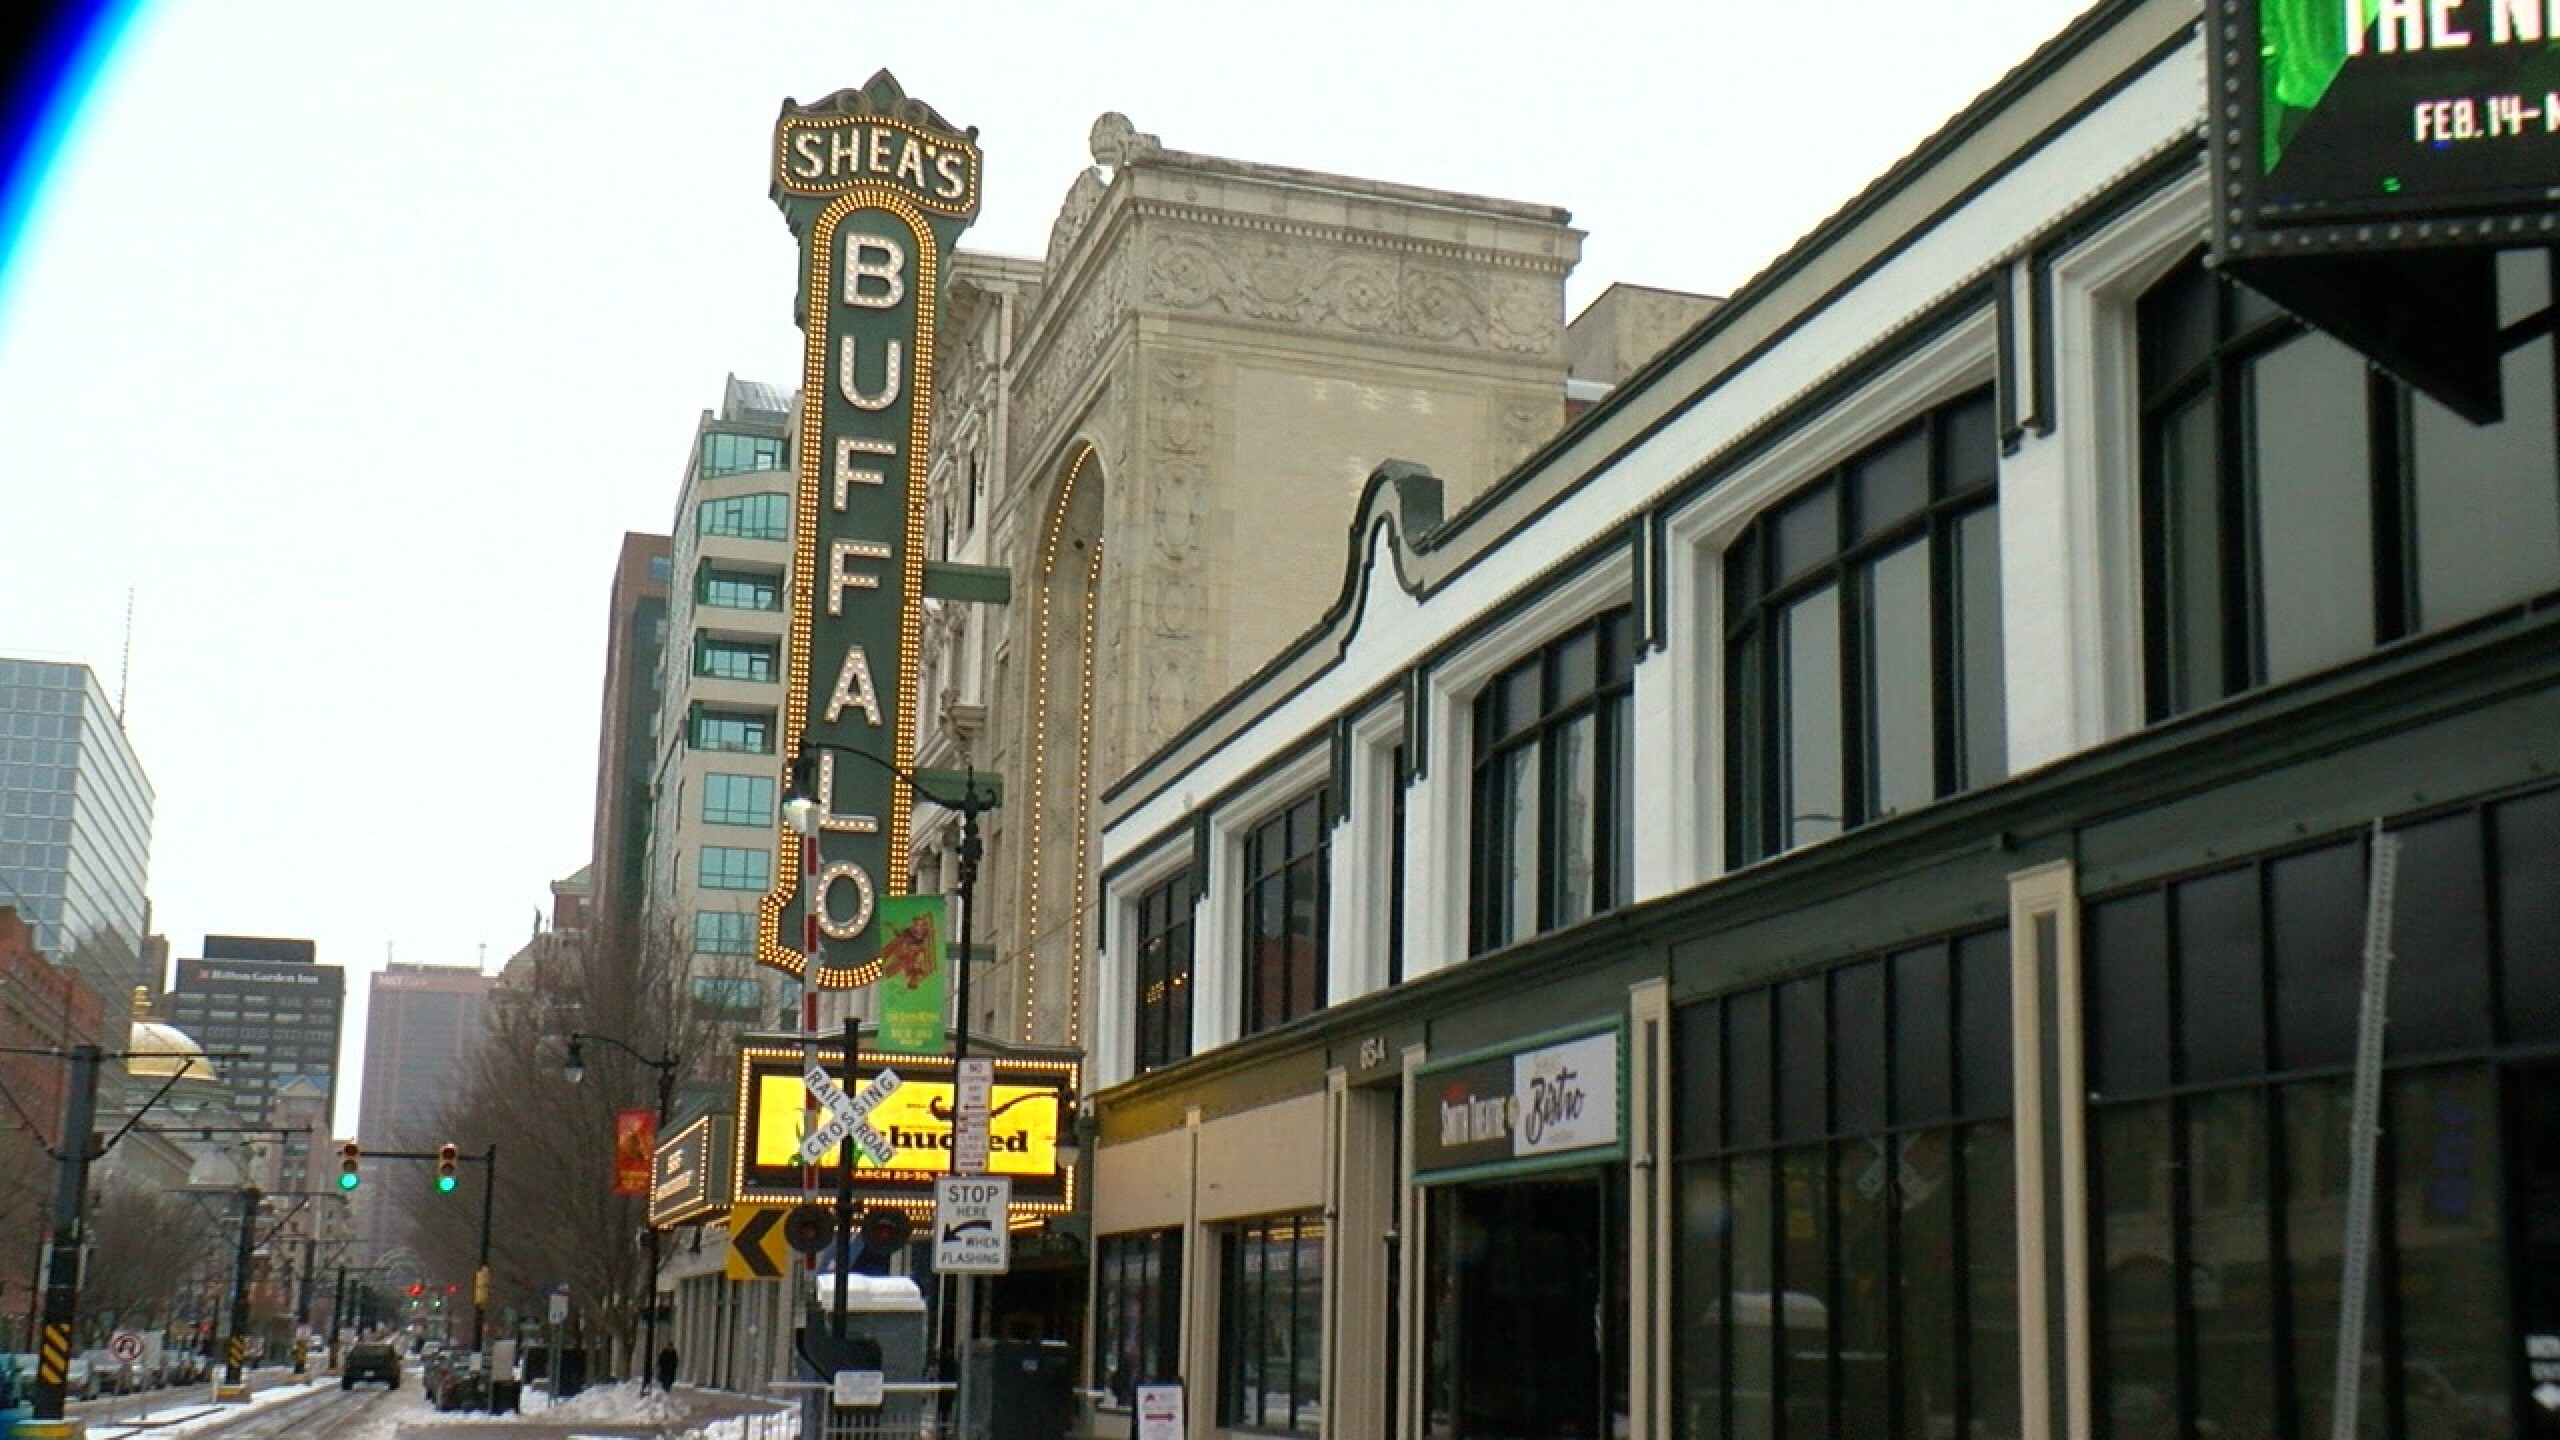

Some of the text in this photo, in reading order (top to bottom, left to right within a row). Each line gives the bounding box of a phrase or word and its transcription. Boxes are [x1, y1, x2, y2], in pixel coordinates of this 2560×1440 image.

[2414, 98, 2484, 142] FEB.
[795, 127, 965, 199] SHEA'S
[817, 231, 905, 939] BUFFALO
[807, 1076, 895, 1157] CROSSING
[1525, 1065, 1586, 1146] Bistro
[947, 1185, 999, 1204] STOP
[956, 1206, 988, 1219] HERE
[941, 1252, 1000, 1265] FLASHING
[965, 1236, 1000, 1249] WHEN
